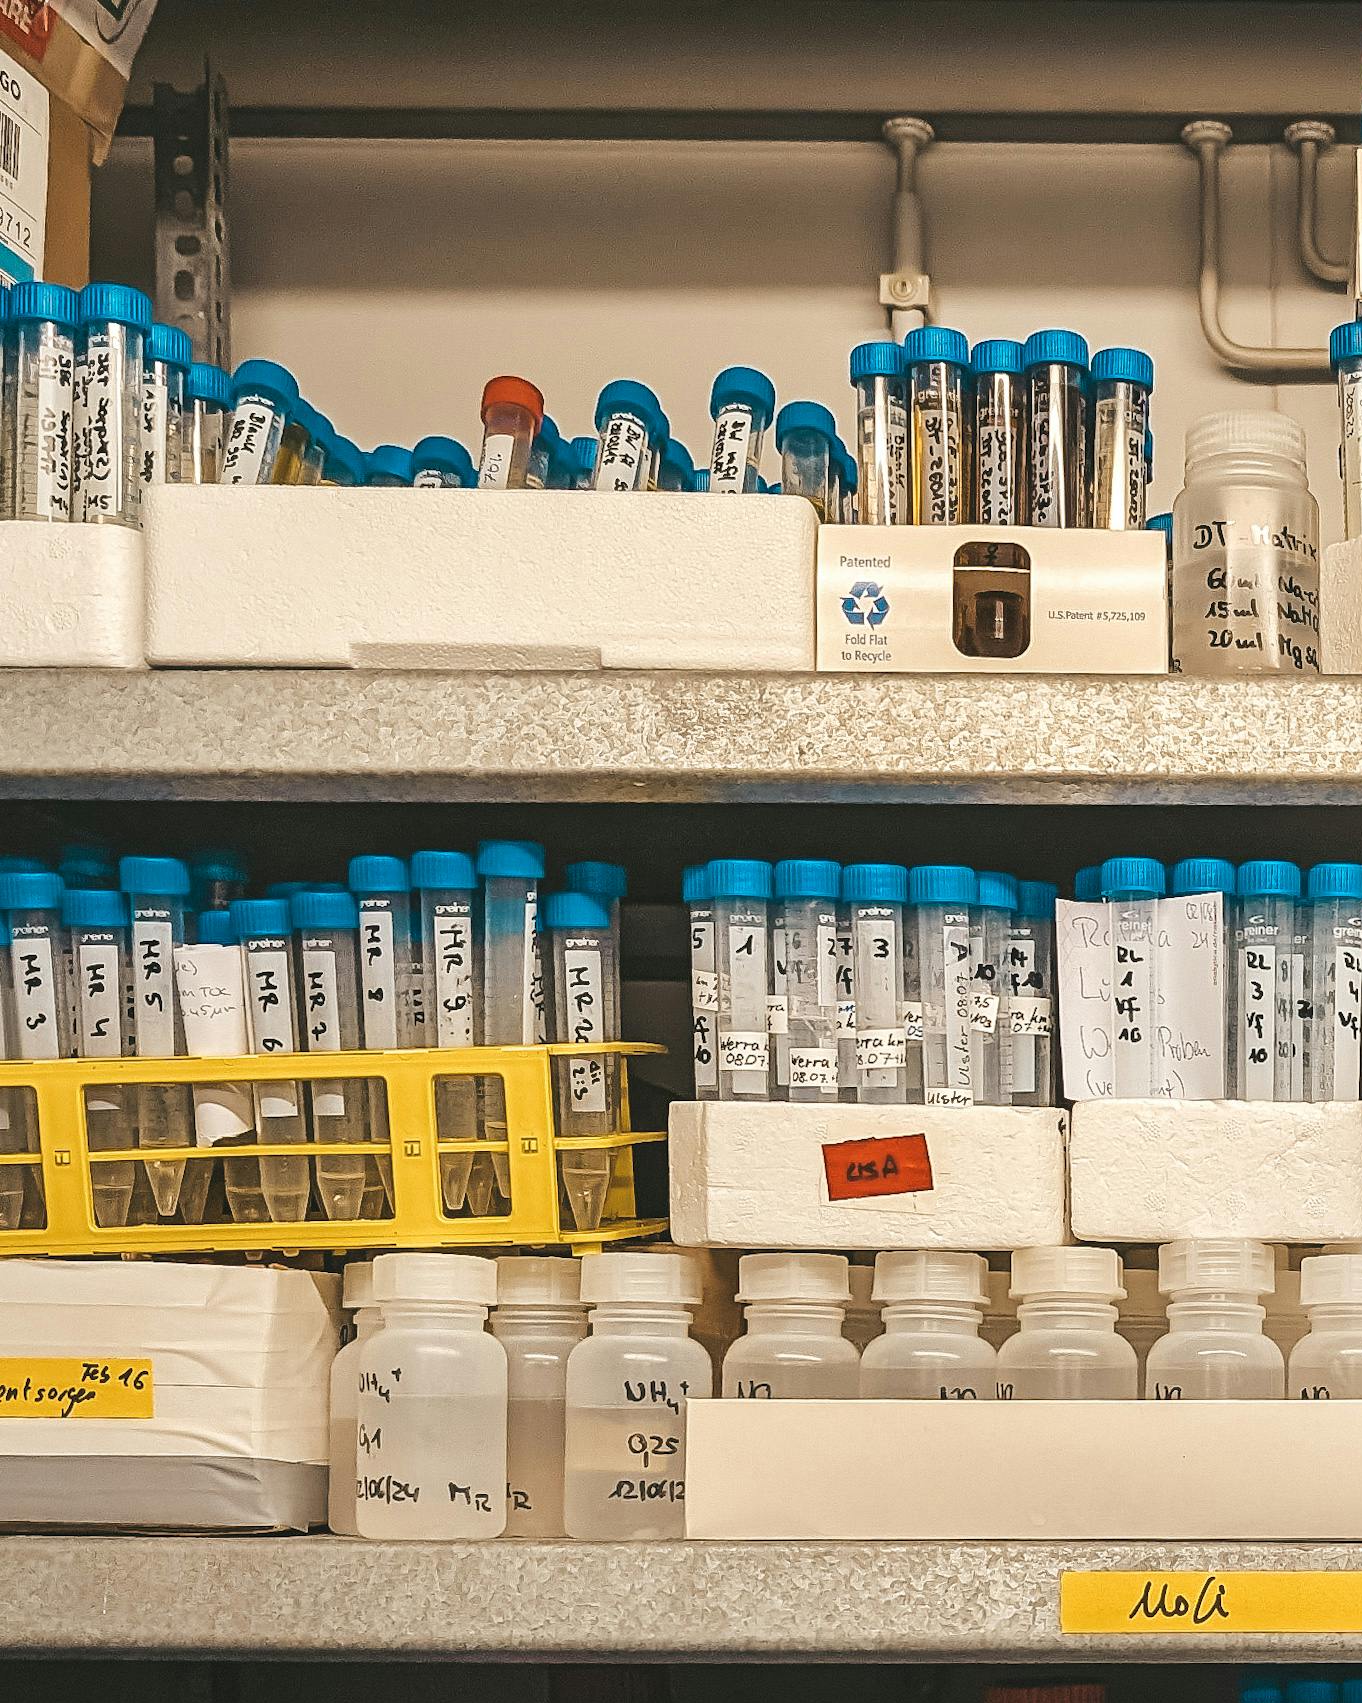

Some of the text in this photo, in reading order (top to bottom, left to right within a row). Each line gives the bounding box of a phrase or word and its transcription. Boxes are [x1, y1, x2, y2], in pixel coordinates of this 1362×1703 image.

[840, 556, 891, 569] Patented
[1096, 611, 1146, 623] #5,725,109
[845, 634, 888, 647] Fold Flat
[841, 650, 892, 665] to Recycle
[857, 907, 894, 918] greiner
[364, 924, 383, 967] MR
[736, 934, 753, 955] 1
[872, 938, 890, 959] 3
[1246, 951, 1271, 970] RL
[86, 963, 106, 998] MR
[140, 939, 164, 1012] MR 5
[1120, 971, 1134, 988] 1
[20, 954, 47, 1031] MR 3
[255, 970, 280, 1013] MR
[307, 971, 327, 1012] MR
[1251, 981, 1264, 1001] 3
[1249, 1048, 1268, 1064] 10
[927, 1087, 972, 1105] Ulster
[118, 1367, 149, 1391] 16
[627, 1432, 679, 1468] 0,25
